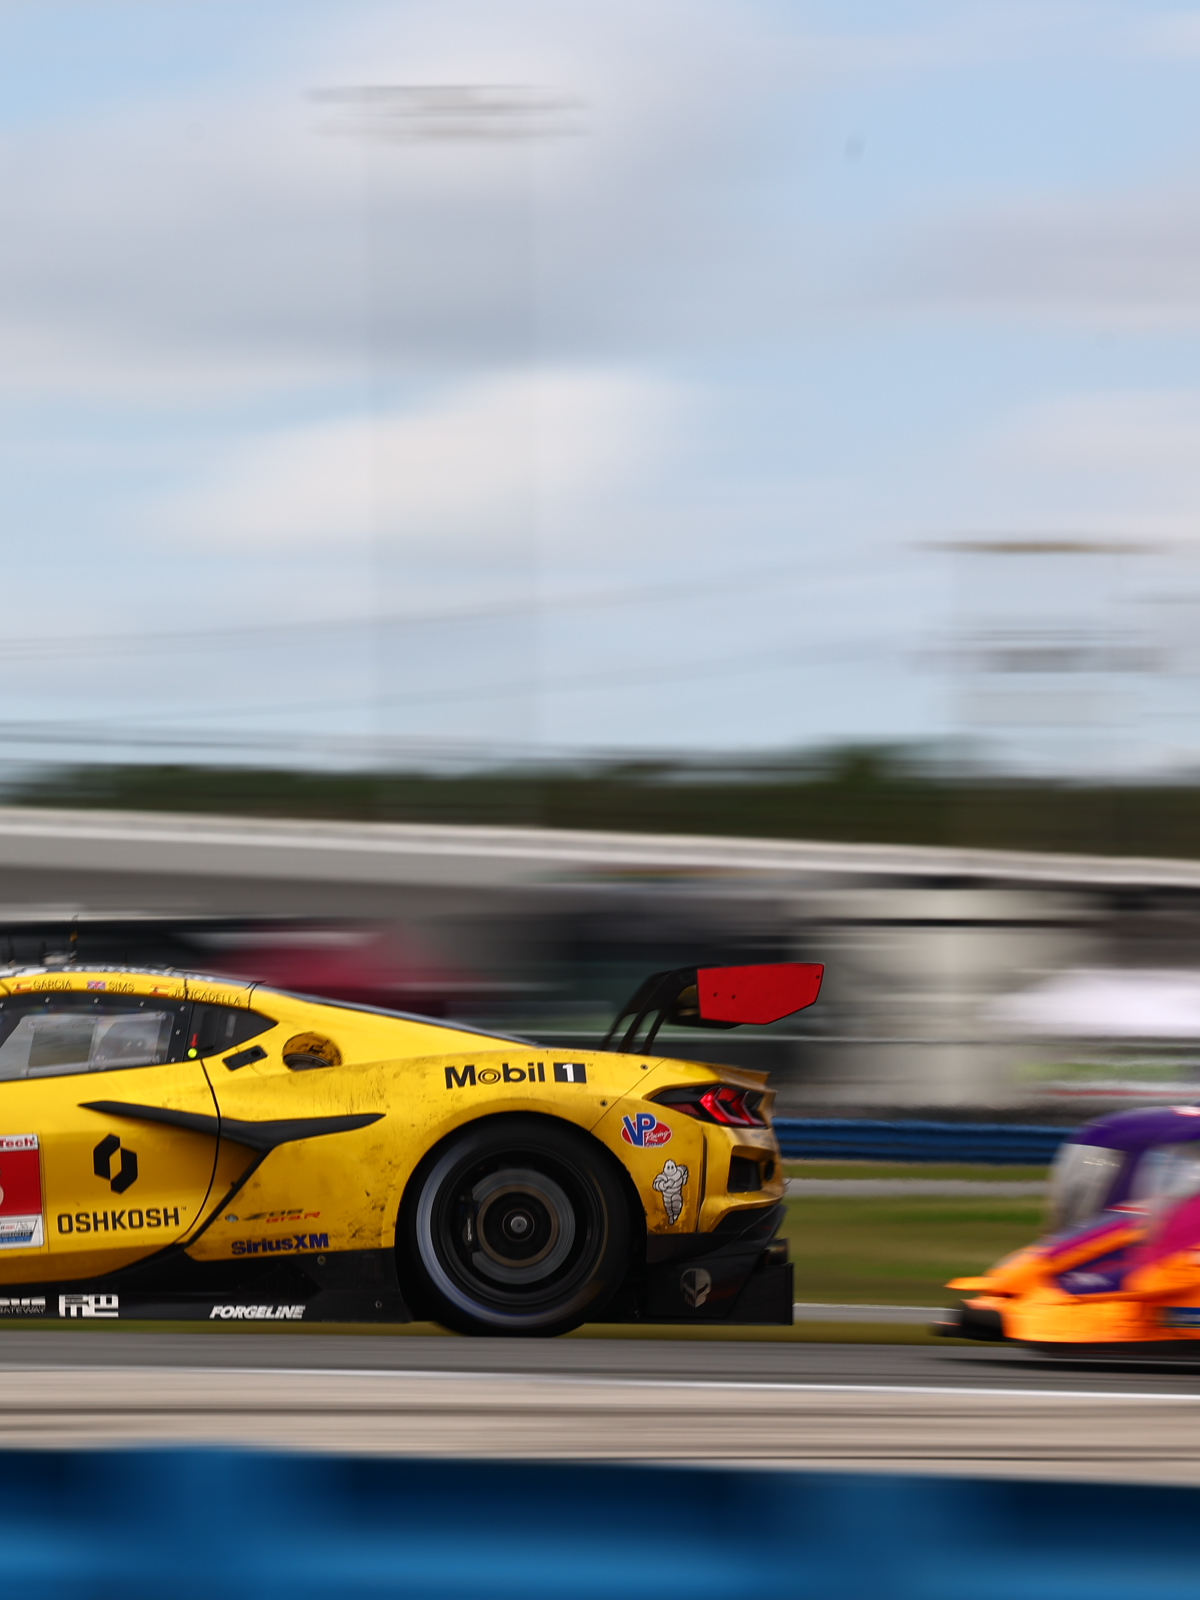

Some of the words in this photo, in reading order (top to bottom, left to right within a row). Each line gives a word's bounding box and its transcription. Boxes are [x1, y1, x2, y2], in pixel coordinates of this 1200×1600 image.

[33, 979, 72, 990] GARCIA
[108, 980, 136, 993] SIMS
[444, 1062, 546, 1090] Mobil
[622, 1112, 657, 1148] VP
[57, 1206, 180, 1235] OSHKOSH
[231, 1233, 329, 1255] SiriusXM
[209, 1304, 306, 1319] FORGELINE
